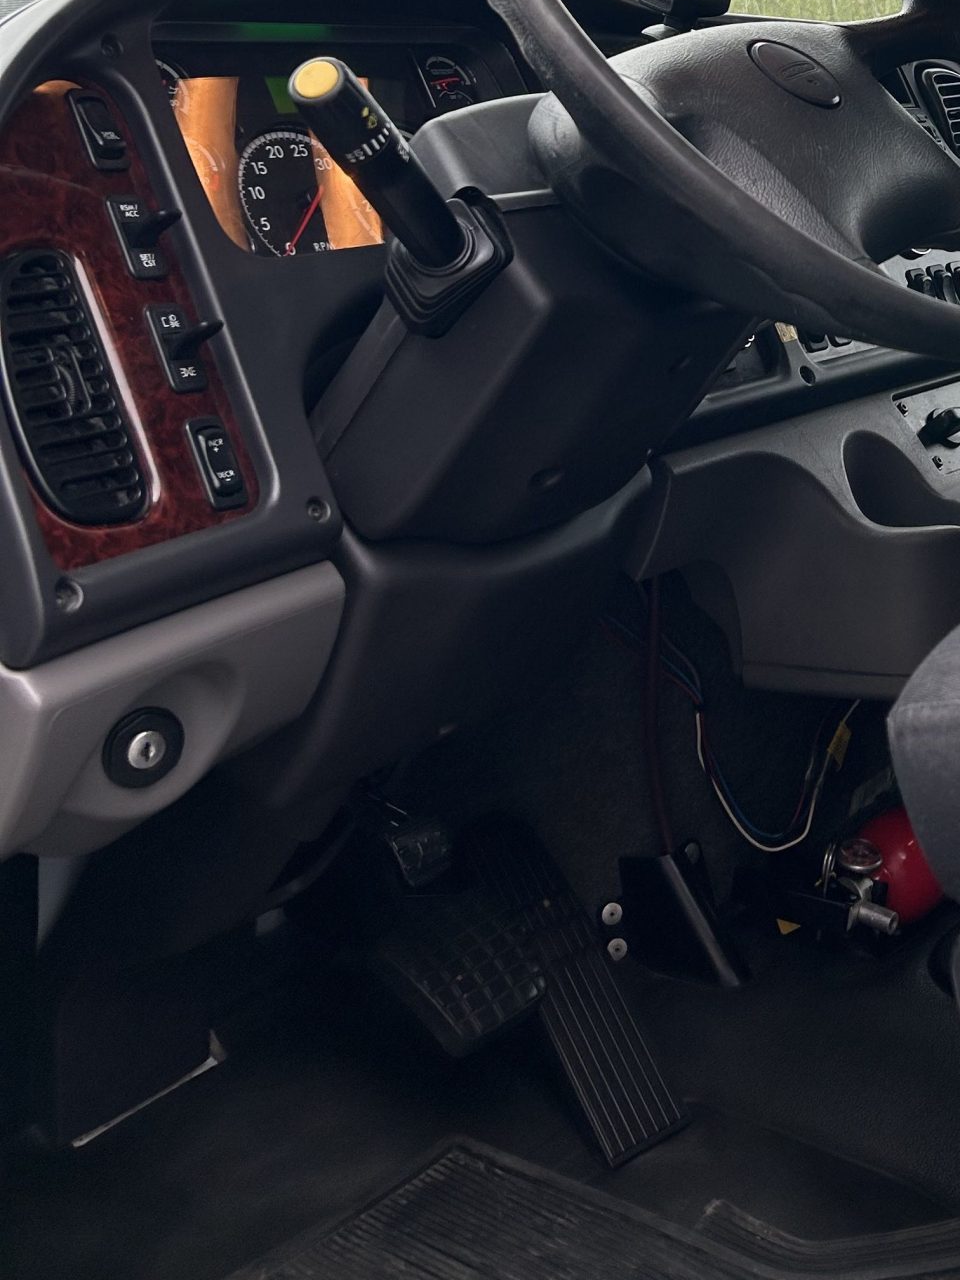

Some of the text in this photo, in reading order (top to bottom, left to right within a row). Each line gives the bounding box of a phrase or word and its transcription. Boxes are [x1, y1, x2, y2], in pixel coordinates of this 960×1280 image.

[265, 145, 285, 159] 20
[290, 144, 309, 157] 25
[250, 161, 268, 175] 15
[315, 158, 332, 171] 30
[248, 186, 266, 200] 10
[260, 217, 271, 231] 5
